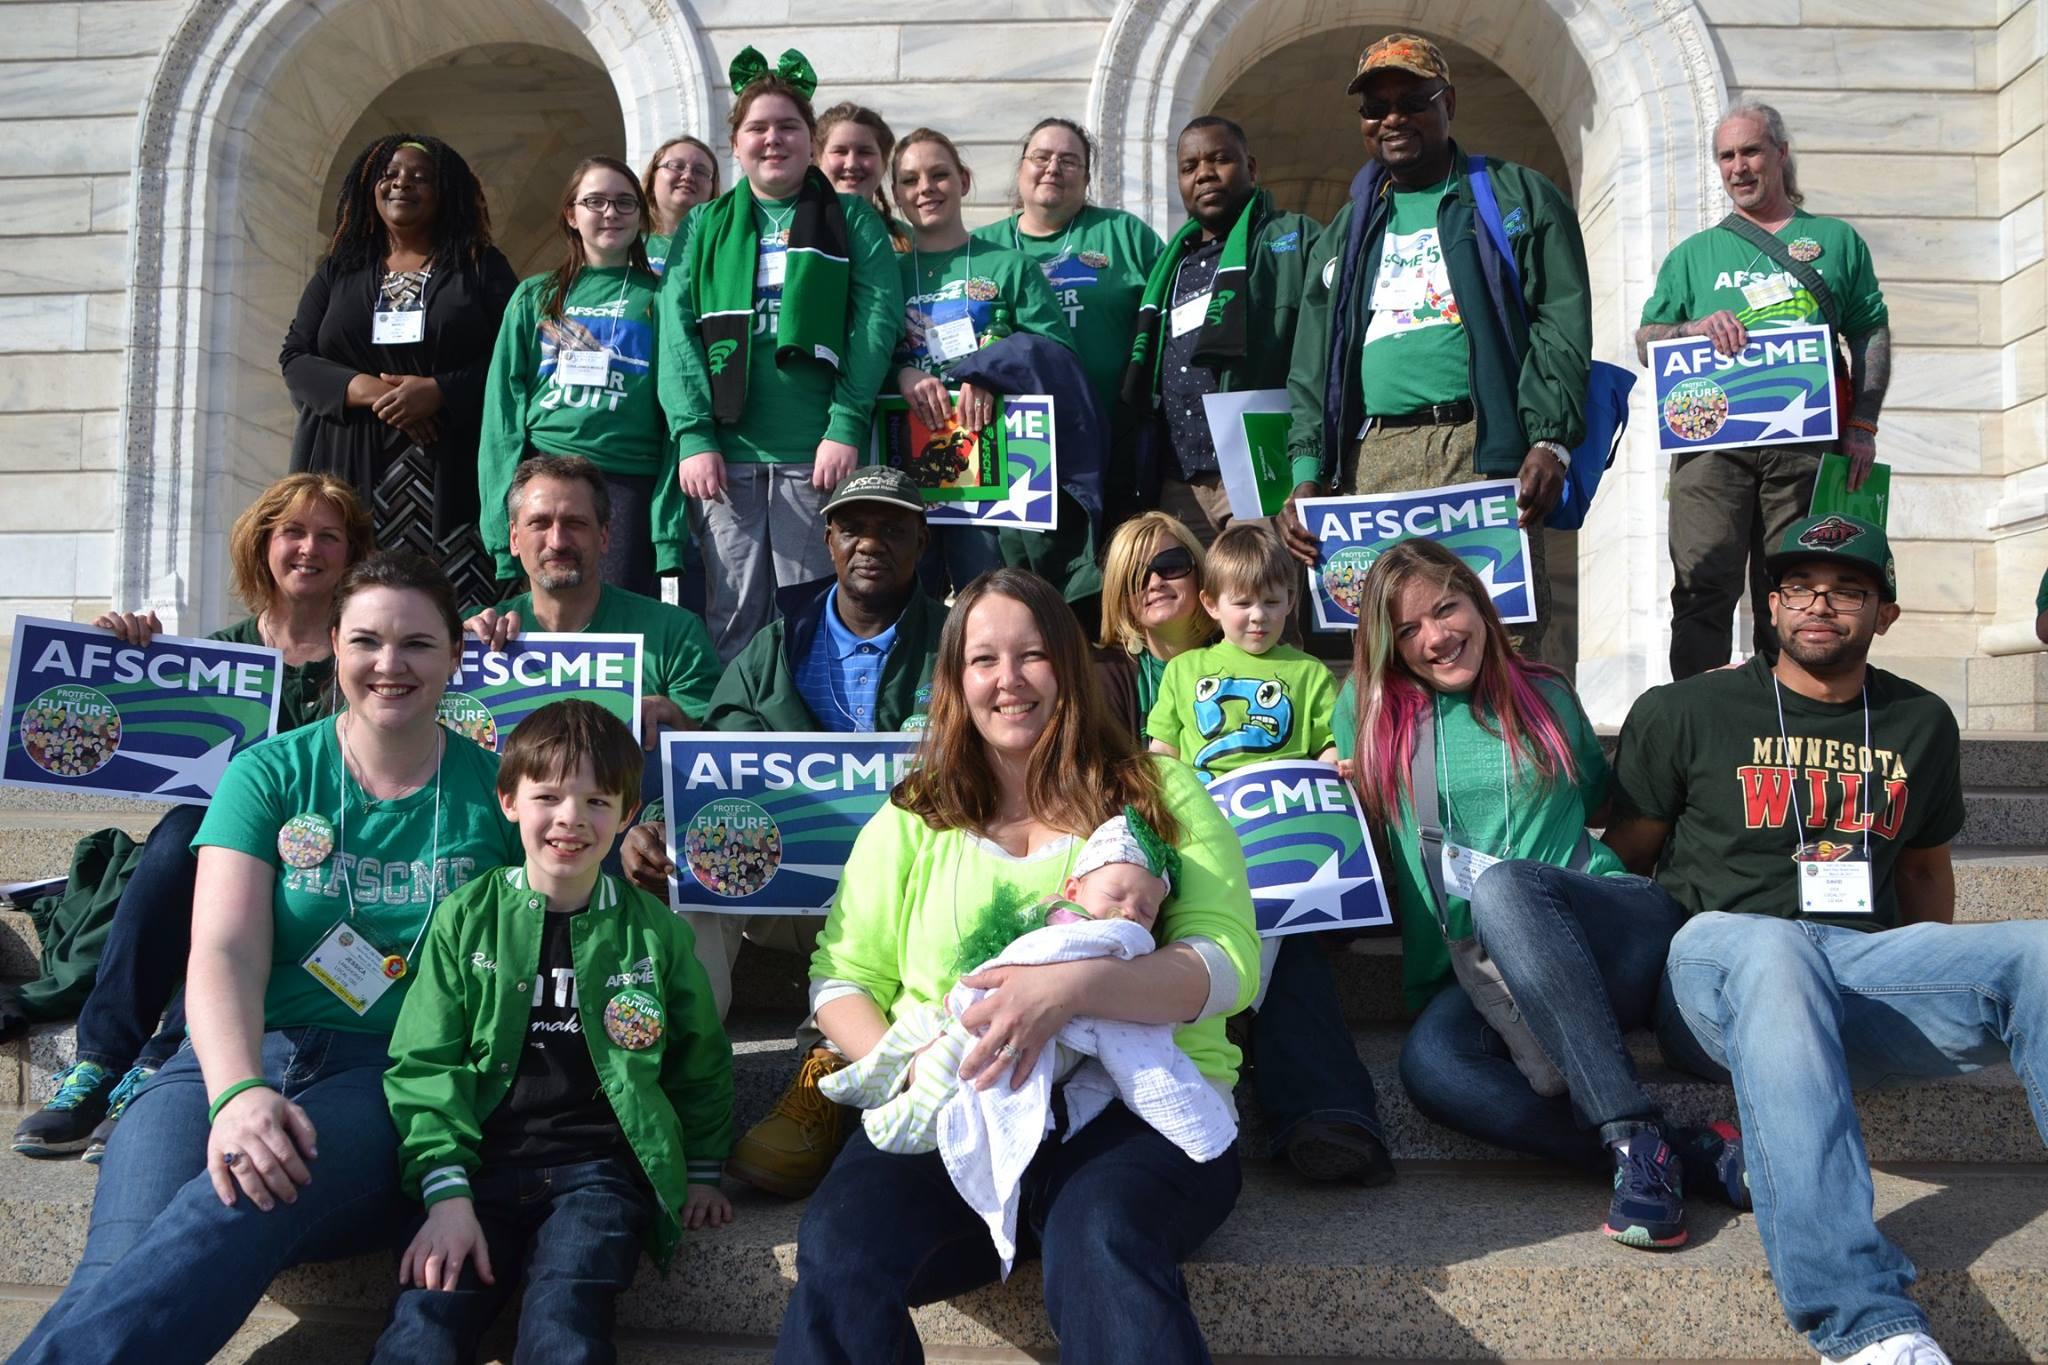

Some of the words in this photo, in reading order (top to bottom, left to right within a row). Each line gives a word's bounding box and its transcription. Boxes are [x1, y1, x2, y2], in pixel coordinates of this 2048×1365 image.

[1384, 252, 1424, 269] SCME
[905, 290, 964, 306] AFSCME
[565, 306, 625, 317] AFSCME
[1663, 338, 1820, 377] AFSCME
[540, 384, 629, 412] QUIT
[1671, 386, 1719, 401] FUTURE
[981, 438, 992, 484] AFSCME
[1319, 495, 1509, 542] AFSCME
[1330, 559, 1375, 571] FUTU
[32, 639, 265, 698] AFSCME
[447, 650, 624, 688] FSCME
[57, 689, 97, 700] PROTECT
[37, 698, 113, 718] FUTURE
[1753, 737, 1908, 779] MINNESOTA
[713, 804, 752, 813] PROTECT
[1737, 765, 1909, 840] WILD
[292, 818, 331, 837] FUTURE
[697, 815, 769, 830] FUTURE
[605, 970, 655, 988] AFSCME
[619, 995, 660, 1019] FUTURE
[532, 1012, 585, 1034] mak
